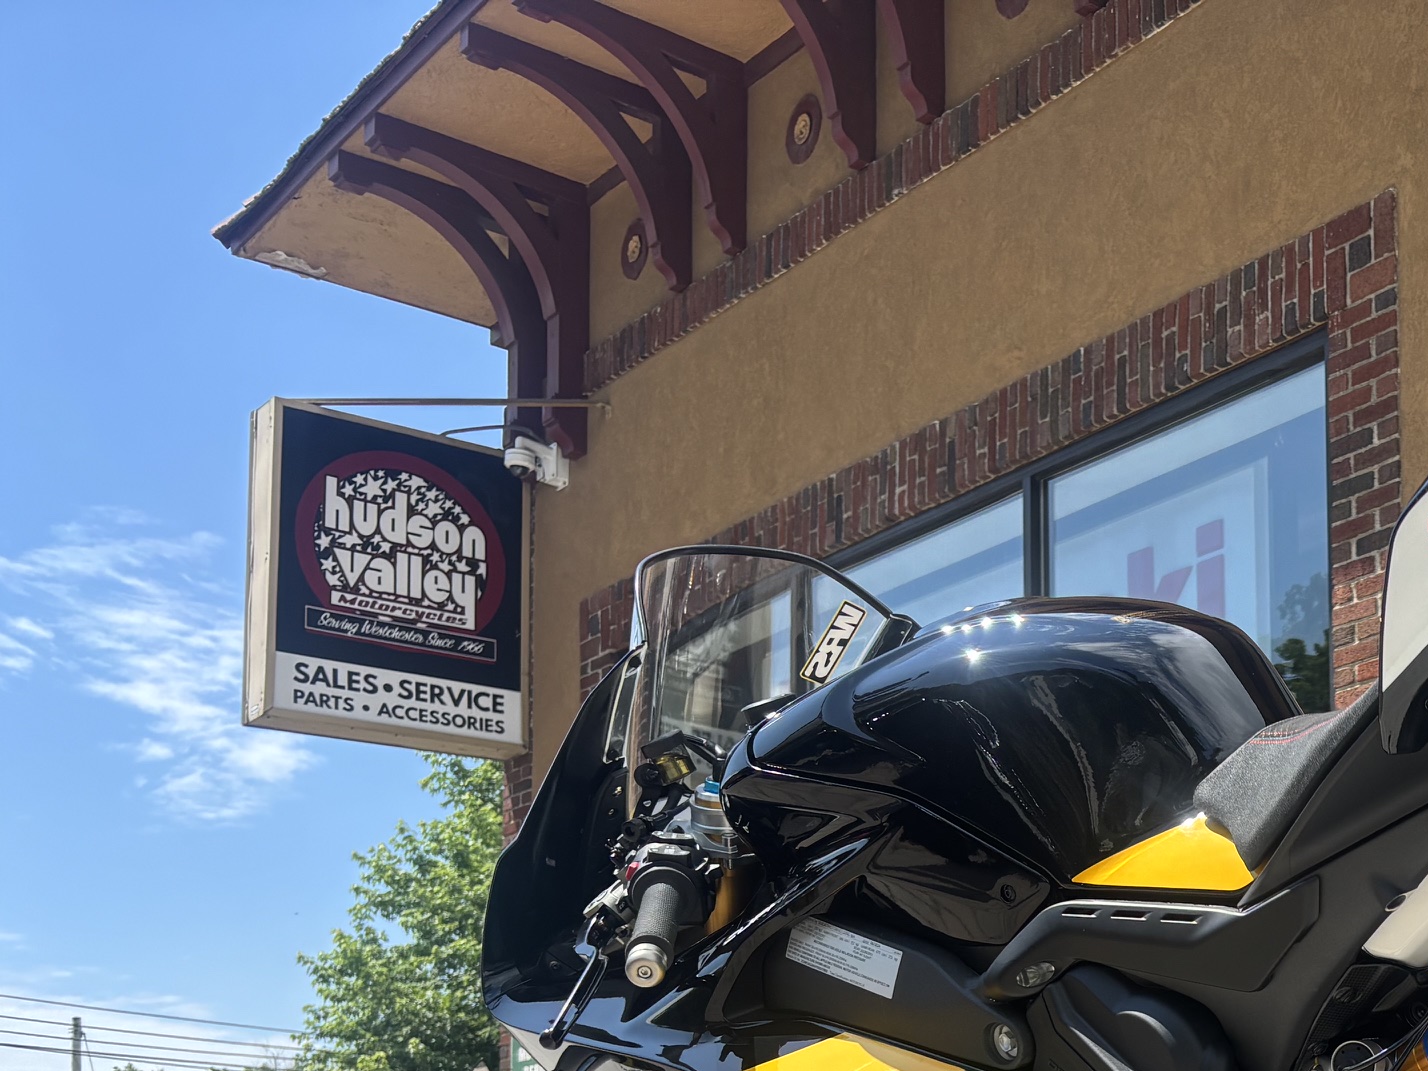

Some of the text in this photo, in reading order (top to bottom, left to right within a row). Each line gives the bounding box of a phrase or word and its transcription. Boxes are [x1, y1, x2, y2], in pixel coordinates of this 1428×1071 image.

[324, 475, 486, 561] hudson
[333, 548, 476, 630] Valley
[338, 594, 468, 627] Motorcycles
[317, 612, 484, 654] Serving Westchester Since 1966
[293, 662, 505, 714] SALES SERVICE
[293, 688, 505, 735] PARTS ACCESSORIES
